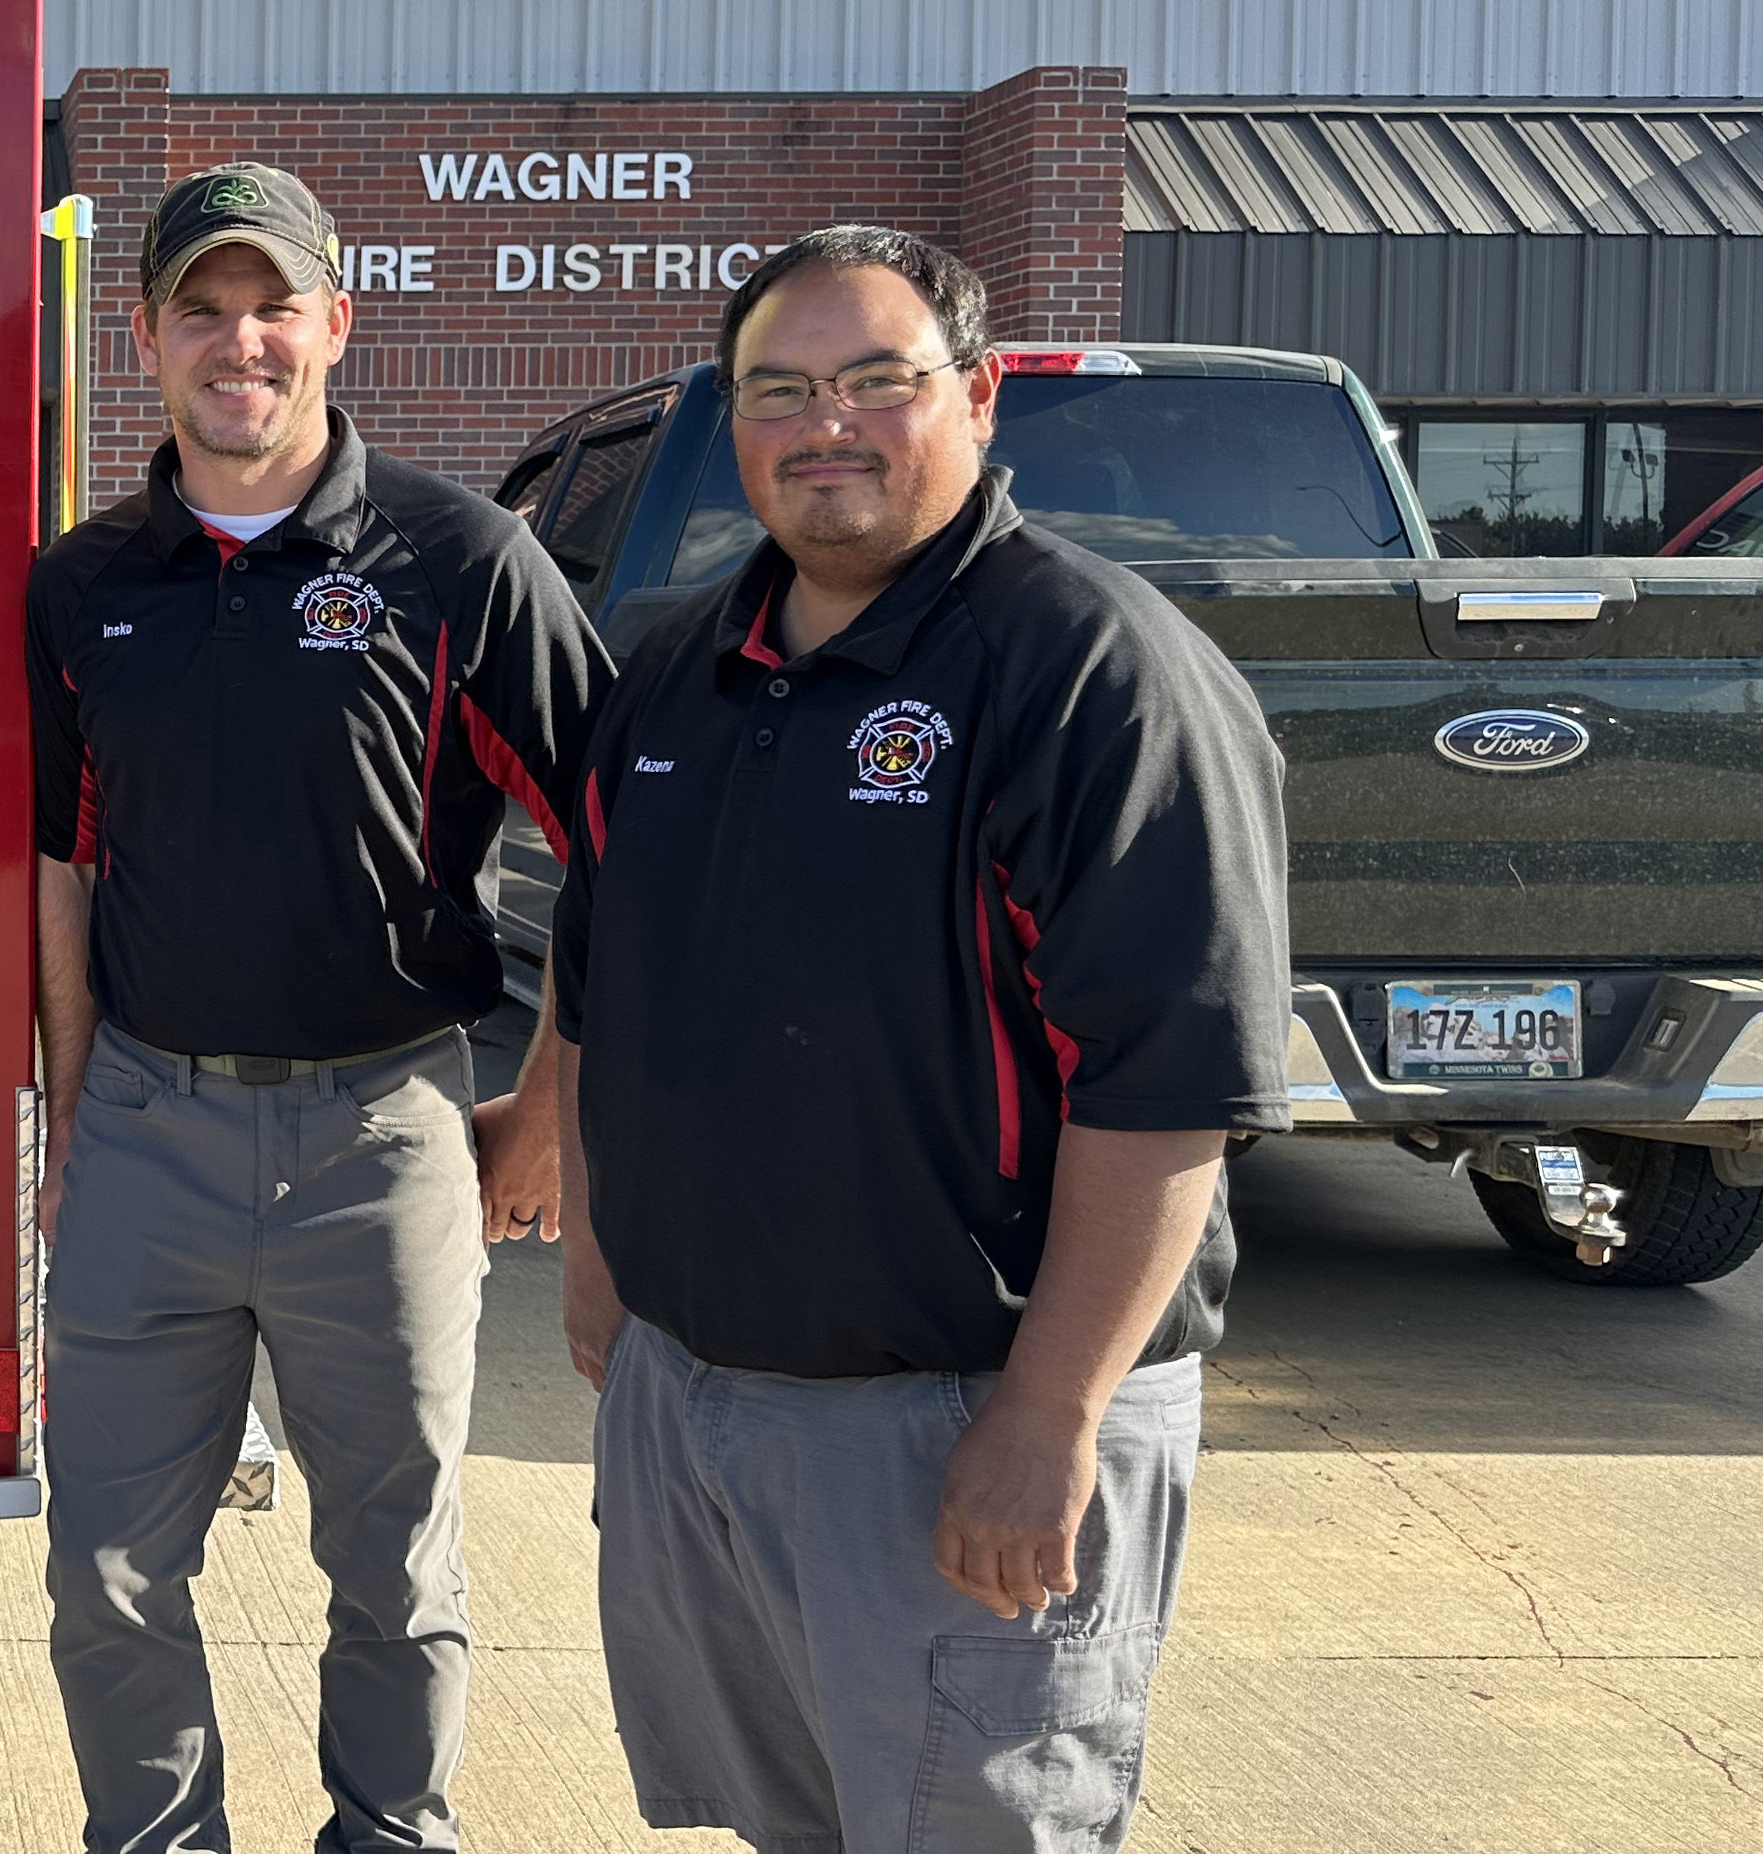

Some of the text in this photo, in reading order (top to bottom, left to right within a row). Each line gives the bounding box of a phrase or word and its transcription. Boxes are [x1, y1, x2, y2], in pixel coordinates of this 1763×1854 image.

[418, 151, 694, 200] WAGNER
[343, 245, 436, 292] IRE
[292, 573, 385, 614] WAGNER FIRE DEPT.
[298, 637, 370, 651] Wagner, SD
[847, 700, 953, 750] WAGNER FIRE DEPT.
[1473, 722, 1556, 756] Ford
[849, 787, 929, 804] Wagner, SD
[1406, 1009, 1560, 1051] 17Z 196
[1444, 1064, 1524, 1075] MINNESOTA TWINS
